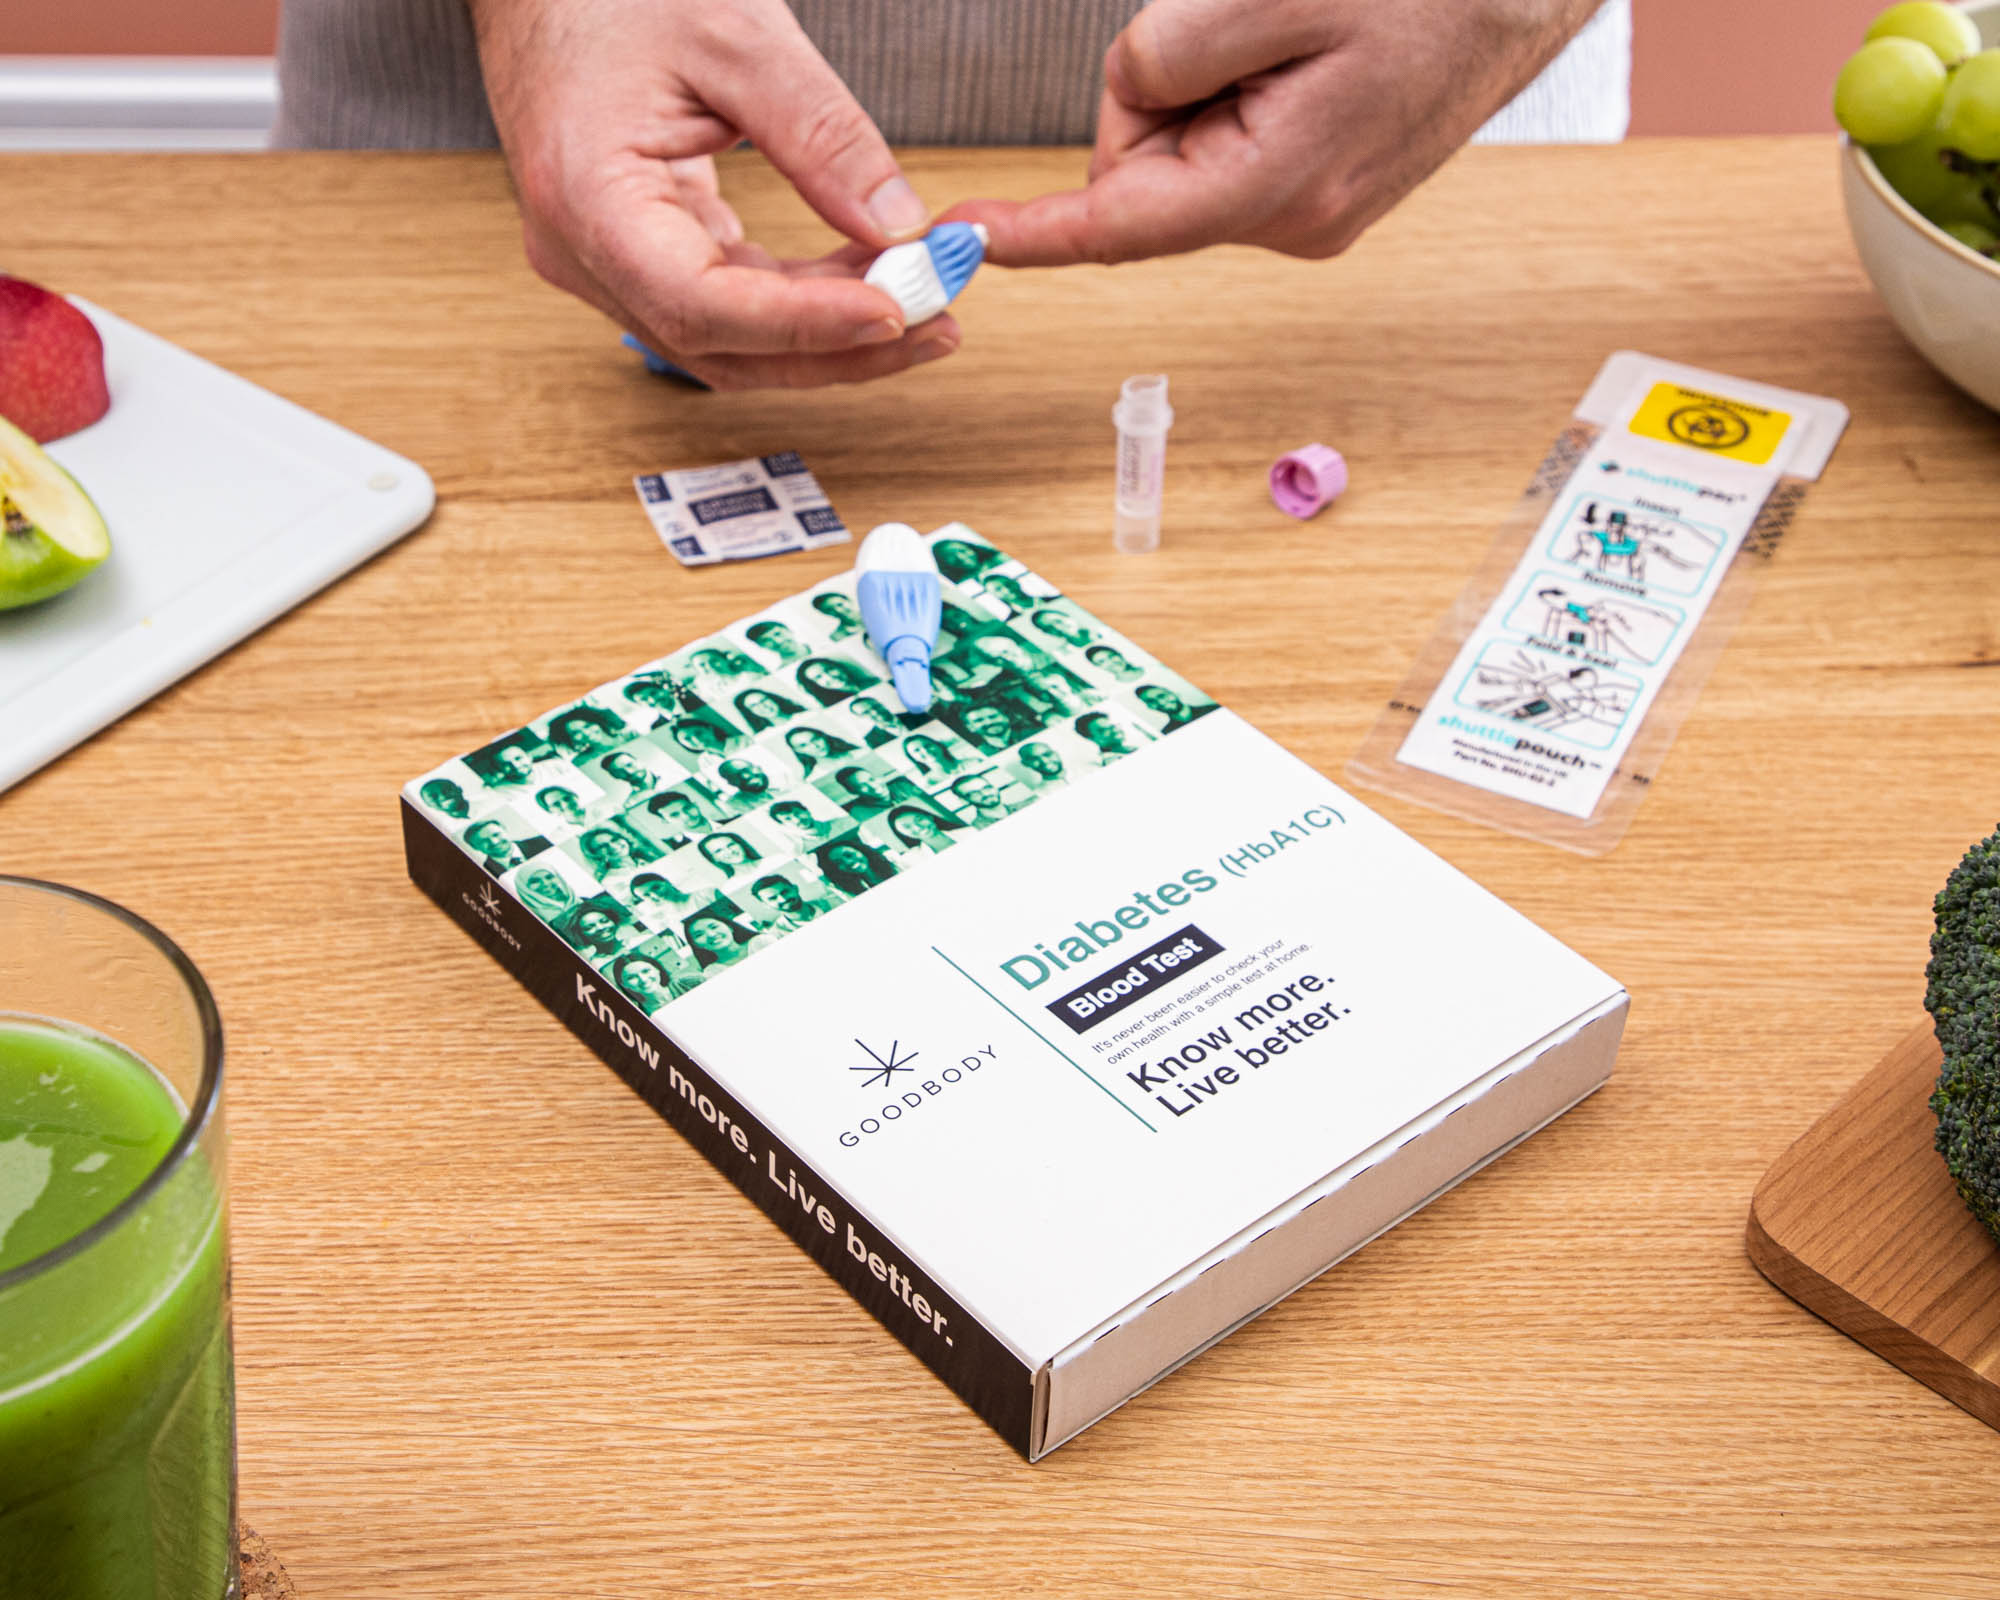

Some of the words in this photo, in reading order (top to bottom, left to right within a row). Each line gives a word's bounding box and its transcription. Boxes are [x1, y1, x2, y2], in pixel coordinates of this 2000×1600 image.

[1634, 497, 1680, 518] Insert
[1584, 571, 1647, 596] Remove
[1453, 750, 1478, 763] Part
[462, 892, 521, 951] GOODBODY
[999, 868, 1218, 991] Diabetes
[1219, 804, 1346, 878] (HbA1C)
[1067, 967, 1149, 1019] Blood
[1140, 937, 1204, 978] Test
[1091, 1041, 1113, 1054] It's
[1112, 1019, 1145, 1042] never
[1144, 1002, 1182, 1023] been
[1177, 980, 1211, 1004] easier
[1210, 972, 1225, 985] to
[1225, 953, 1258, 977] check
[1258, 939, 1285, 959] your
[1107, 1049, 1133, 1065] own
[1132, 1023, 1171, 1049] health
[1170, 1010, 1196, 1028] with
[1196, 1003, 1206, 1013] a
[1204, 982, 1242, 1007] simple
[1240, 967, 1266, 985] test
[1264, 960, 1279, 973] at
[1275, 943, 1313, 966] home.
[1126, 1025, 1233, 1093] Know
[1234, 974, 1335, 1032] more.
[1155, 1065, 1240, 1118] Live
[1234, 1000, 1352, 1069] better.
[839, 1044, 996, 1147] GOODBODY
[576, 972, 660, 1071] Know
[669, 1064, 757, 1164] more.
[768, 1149, 837, 1235] Live
[847, 1223, 954, 1347] better.
